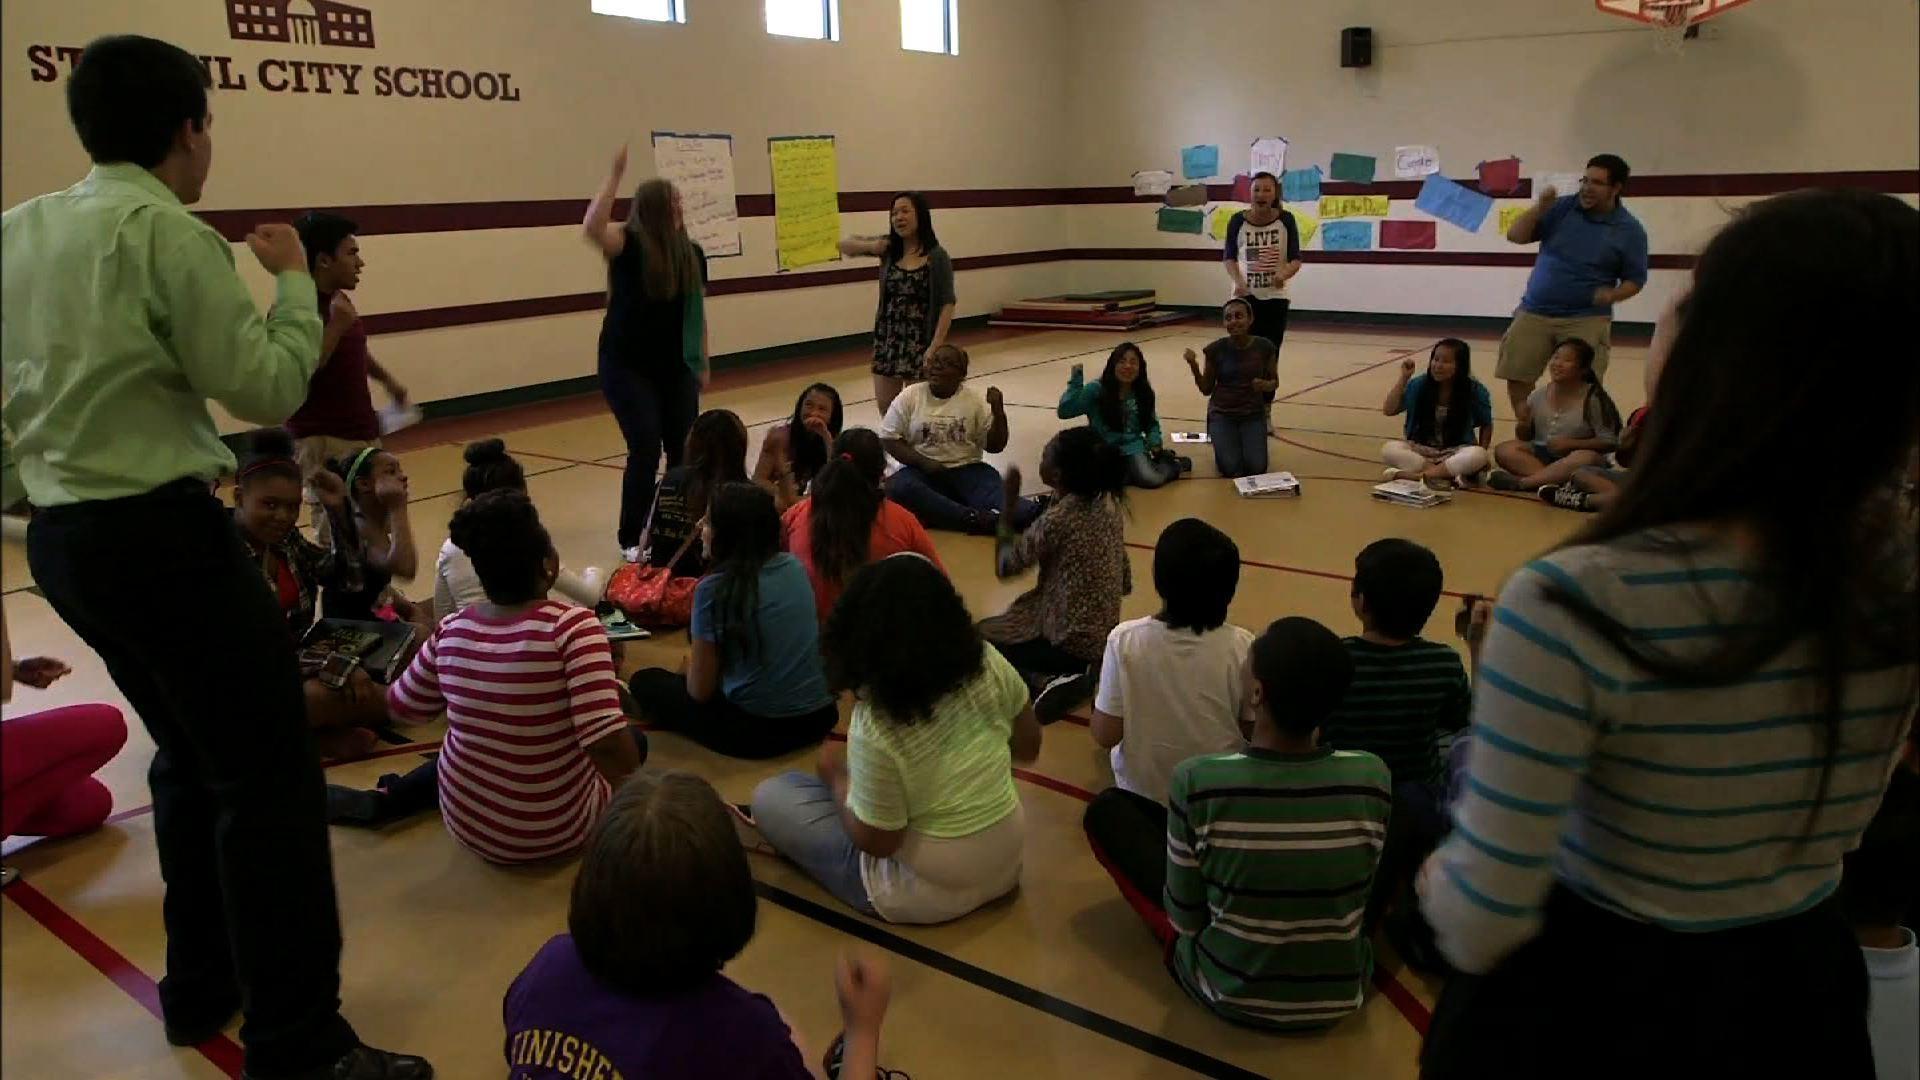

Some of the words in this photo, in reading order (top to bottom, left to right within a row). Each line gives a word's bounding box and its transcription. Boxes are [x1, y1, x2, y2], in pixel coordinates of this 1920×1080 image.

[258, 59, 362, 95] CITY
[374, 65, 520, 102] SCHOOL
[1246, 229, 1280, 246] LIVE
